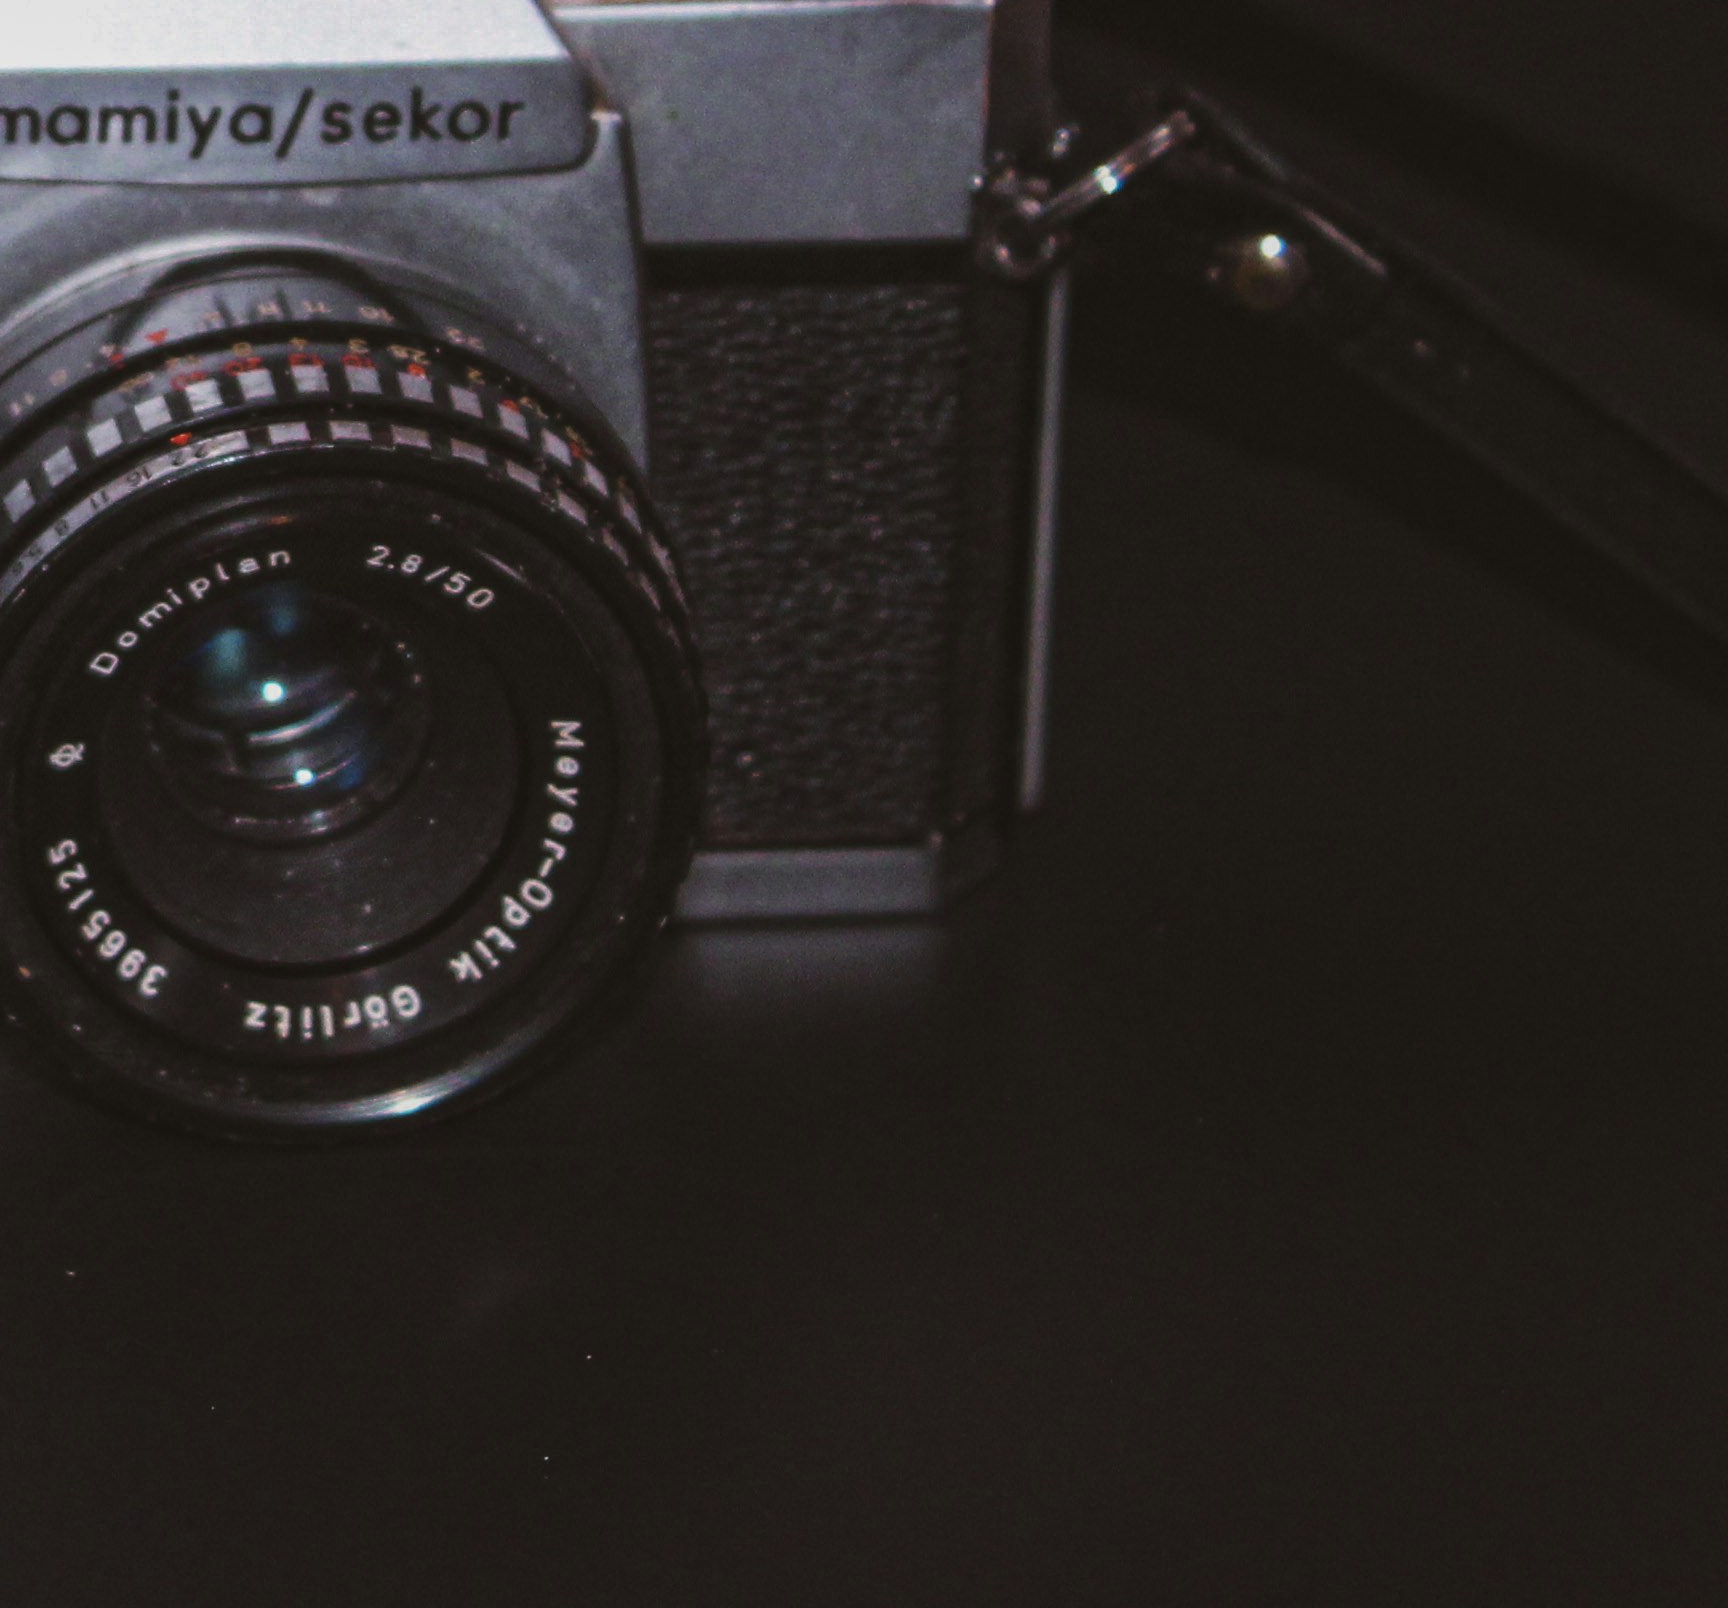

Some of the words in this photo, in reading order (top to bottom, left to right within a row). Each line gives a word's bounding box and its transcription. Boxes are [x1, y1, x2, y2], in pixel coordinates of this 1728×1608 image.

[88, 547, 292, 677] Domiplan
[366, 544, 495, 610] 2.8/50
[47, 837, 169, 997] 3965125
[447, 719, 584, 983] Meyer-Optik
[243, 983, 422, 1041] Görlitz
